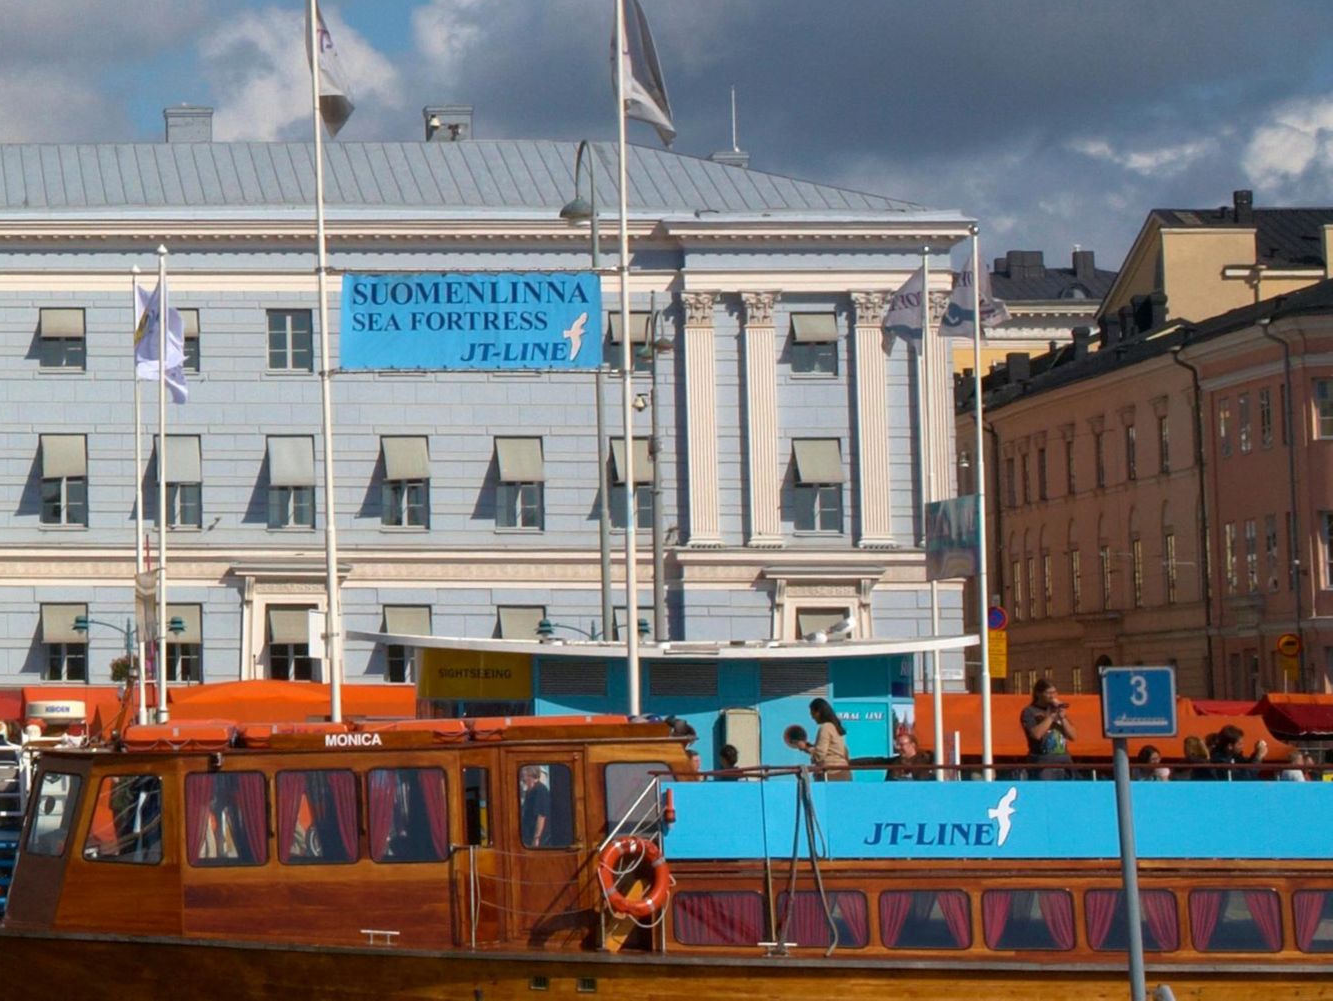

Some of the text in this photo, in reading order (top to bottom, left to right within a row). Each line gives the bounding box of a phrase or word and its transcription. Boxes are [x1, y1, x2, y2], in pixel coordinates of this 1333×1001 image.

[352, 280, 589, 306] SUOMENLINNA
[352, 311, 548, 332] SEA FORTRESS
[460, 342, 568, 362] JT-LINE
[438, 668, 512, 680] SIGHTSEEING
[1130, 675, 1148, 706] 3
[865, 711, 884, 720] LINE
[325, 733, 382, 747] MONICA
[863, 822, 995, 846] JT-LINE
